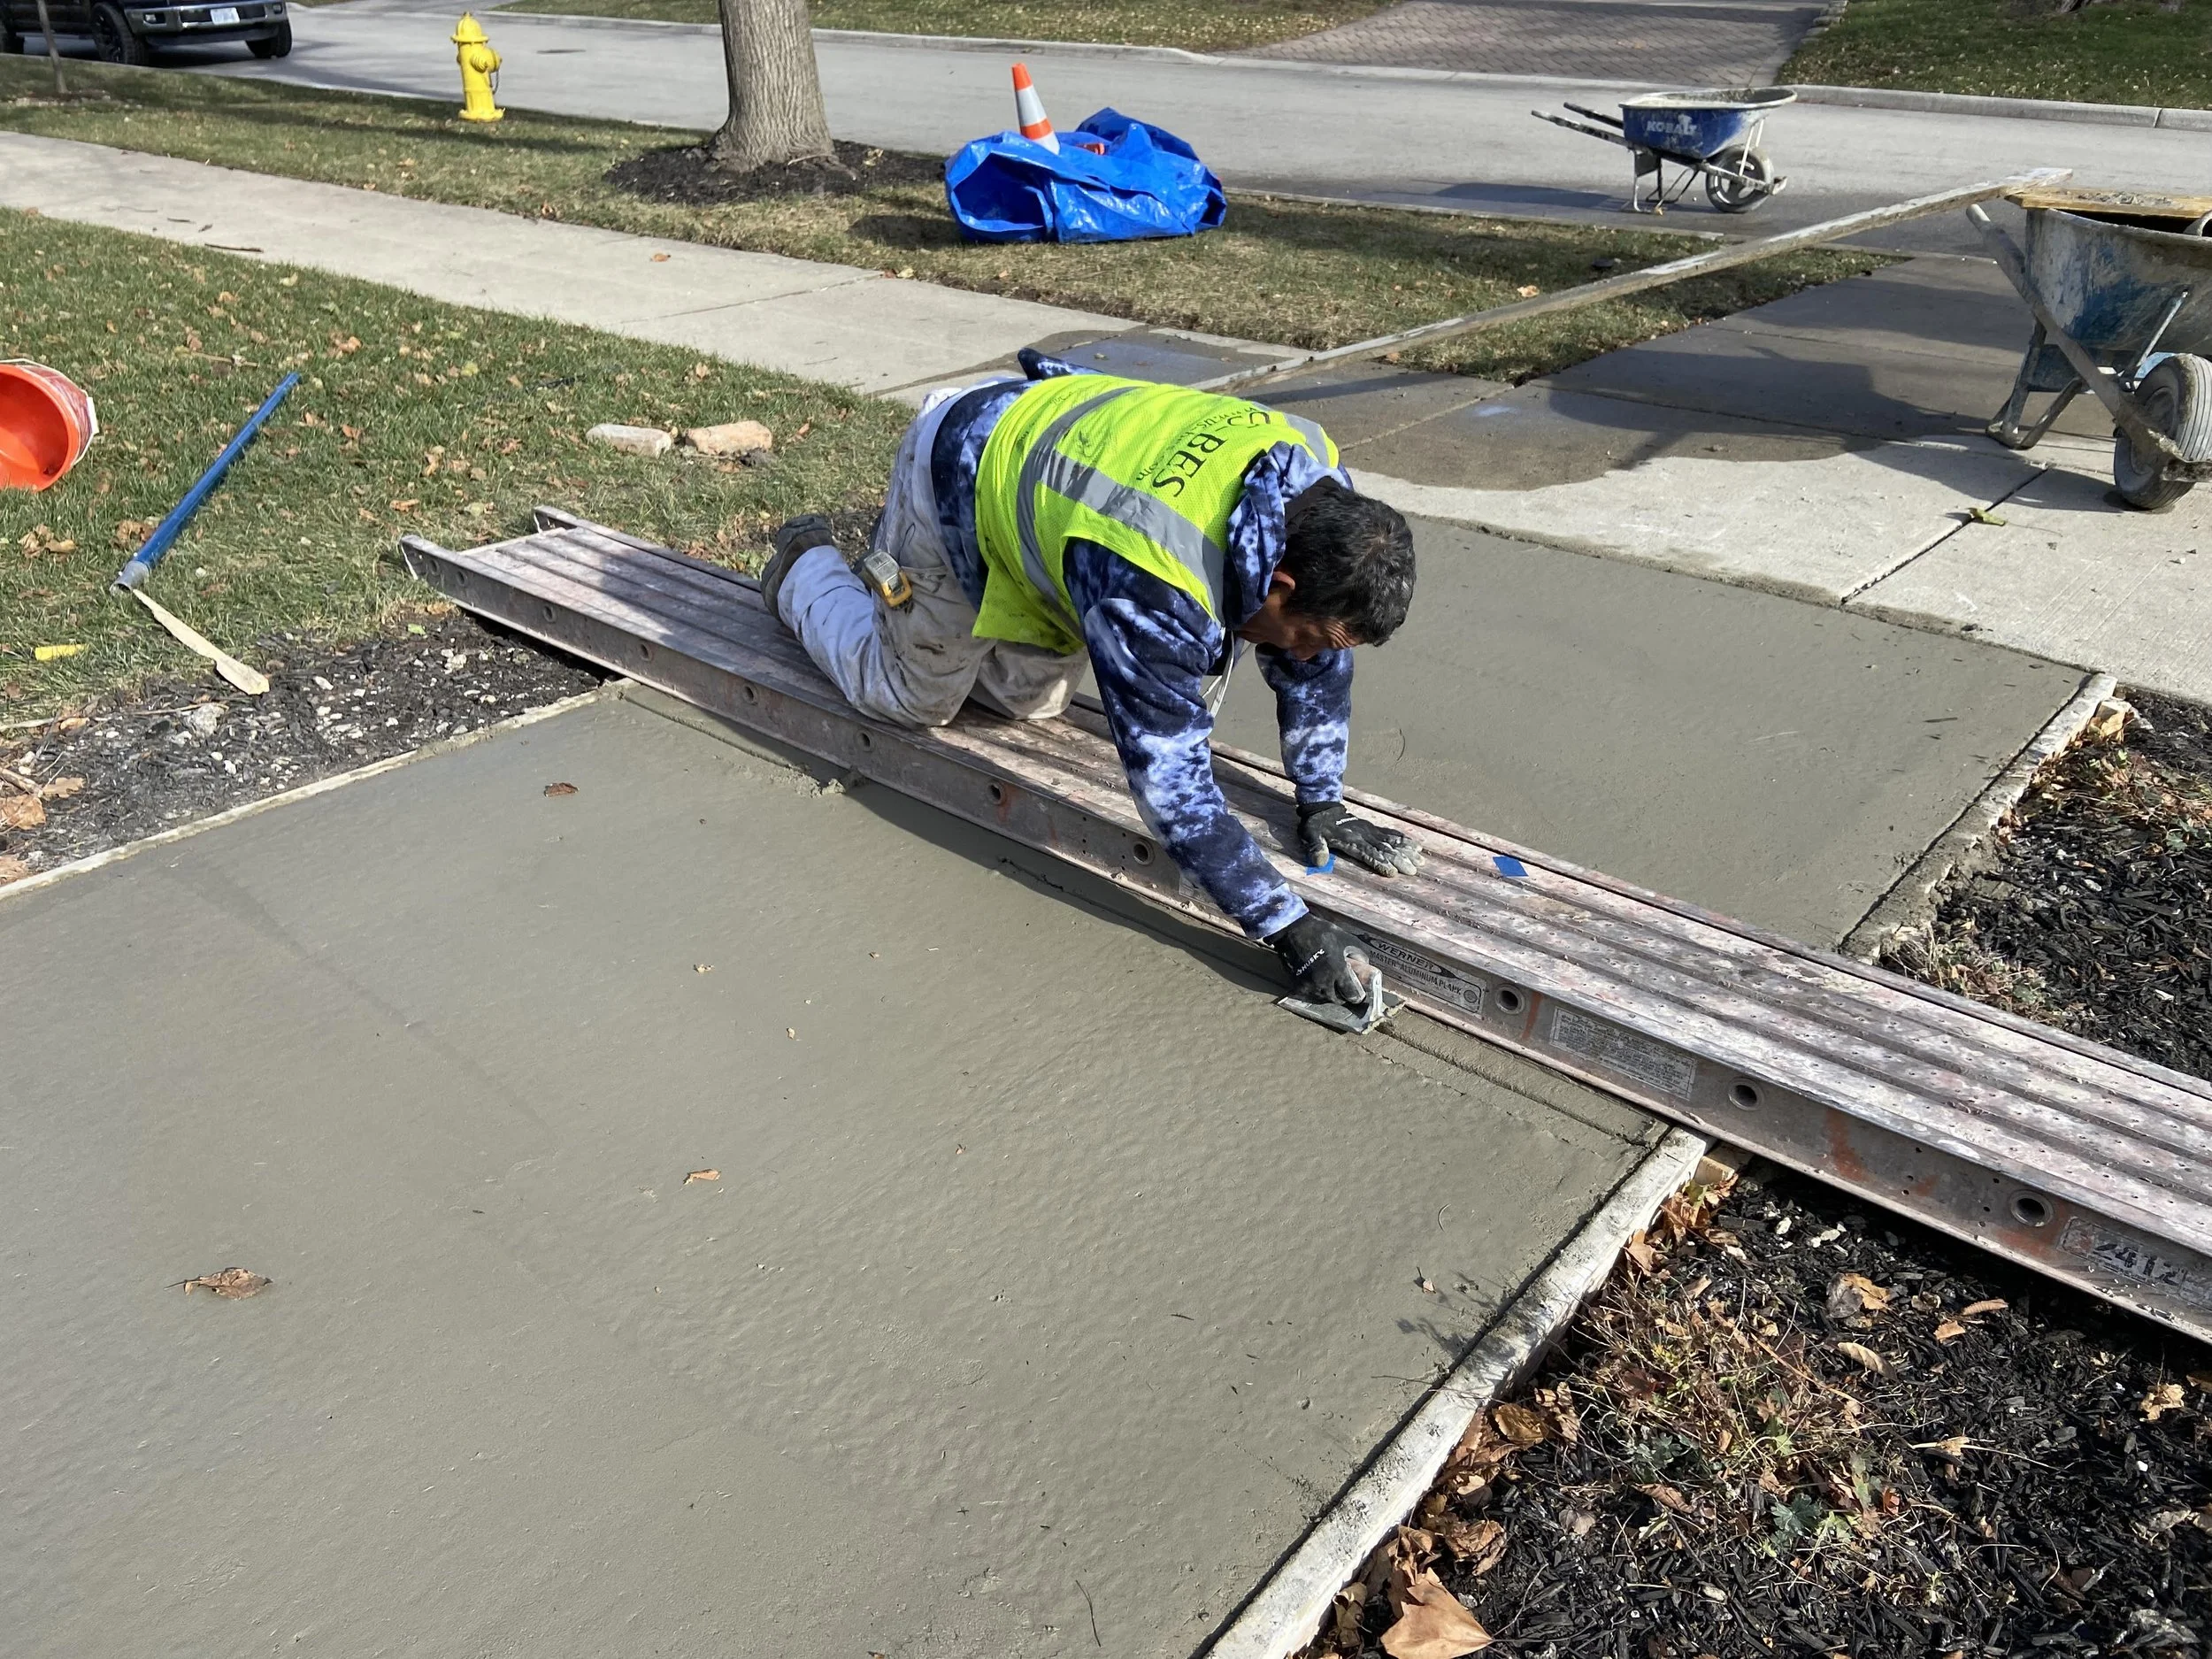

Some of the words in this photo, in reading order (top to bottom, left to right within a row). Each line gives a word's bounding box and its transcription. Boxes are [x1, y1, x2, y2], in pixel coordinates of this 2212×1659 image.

[1647, 120, 1697, 135] KOBALT
[1302, 949, 1325, 972] HUSKY
[1378, 941, 1434, 971] WERNER
[1400, 964, 1438, 987] ALUMINUM
